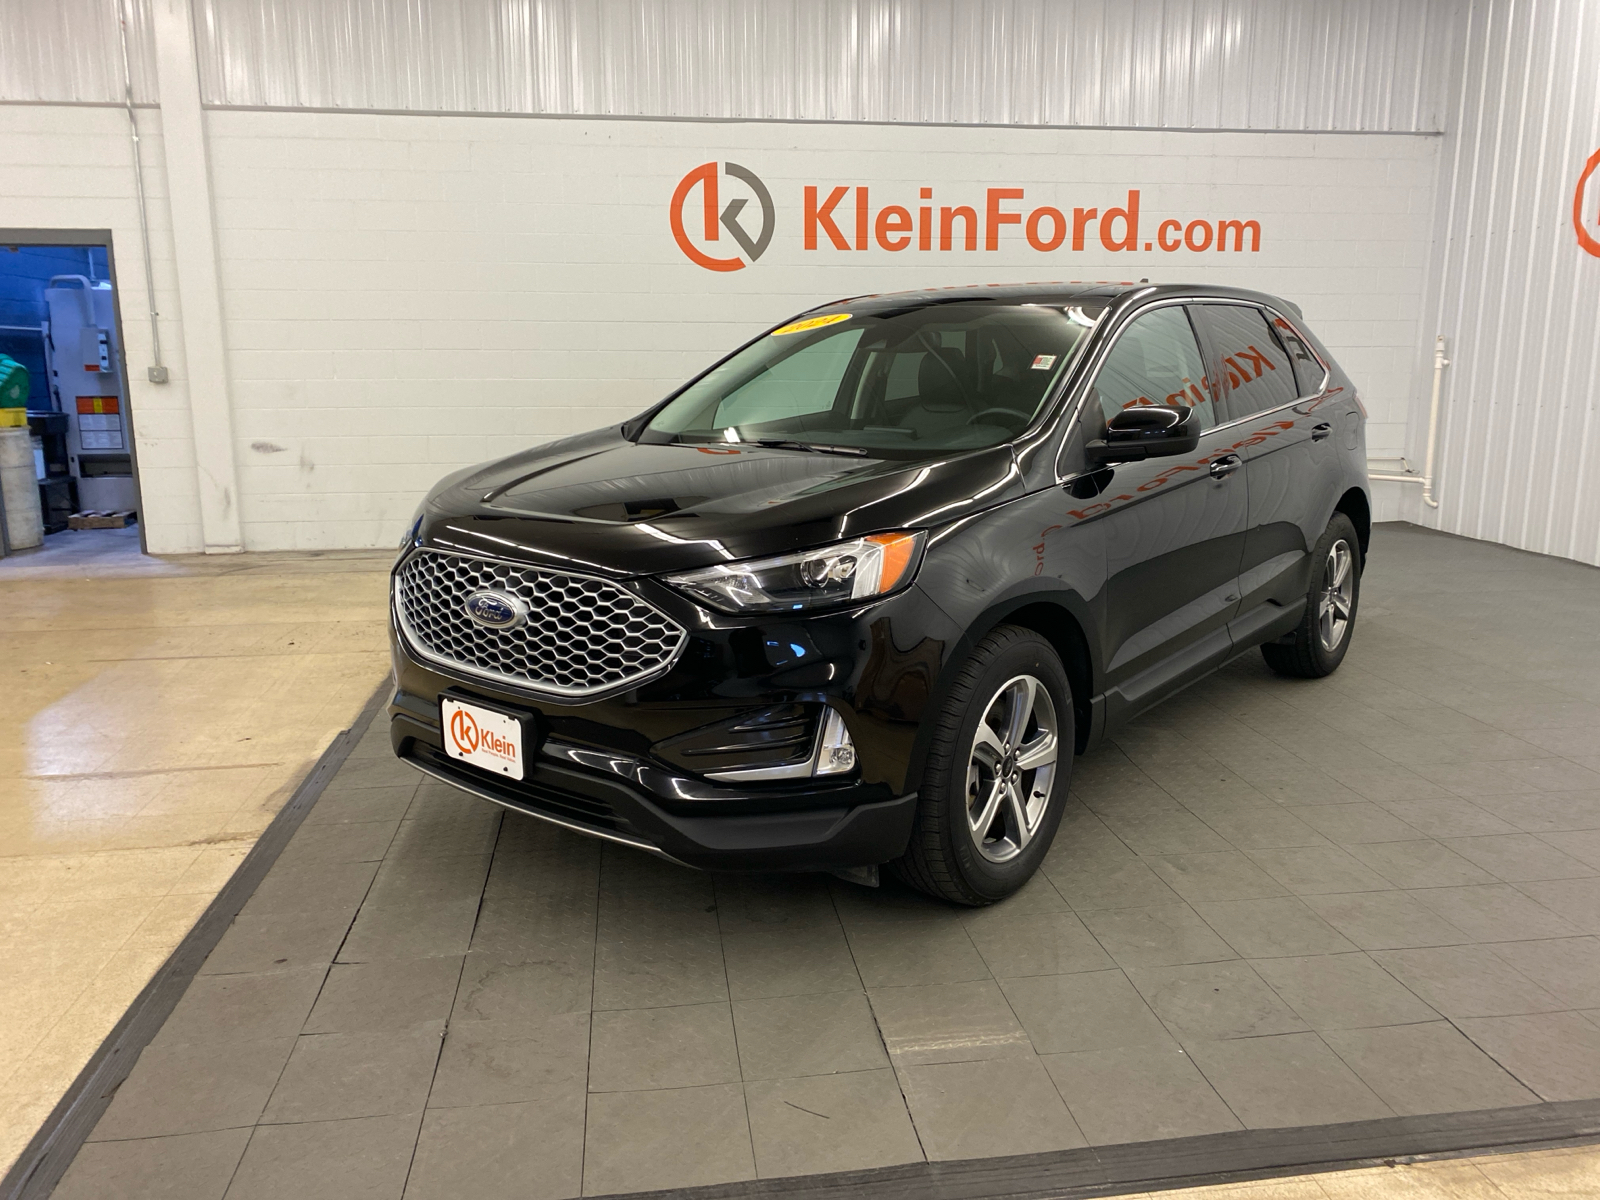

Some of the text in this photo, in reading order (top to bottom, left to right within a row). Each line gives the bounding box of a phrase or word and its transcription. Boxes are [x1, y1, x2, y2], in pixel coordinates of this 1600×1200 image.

[803, 185, 1262, 253] KleinFord.com
[474, 596, 505, 620] Ford
[480, 728, 516, 758] Klein
